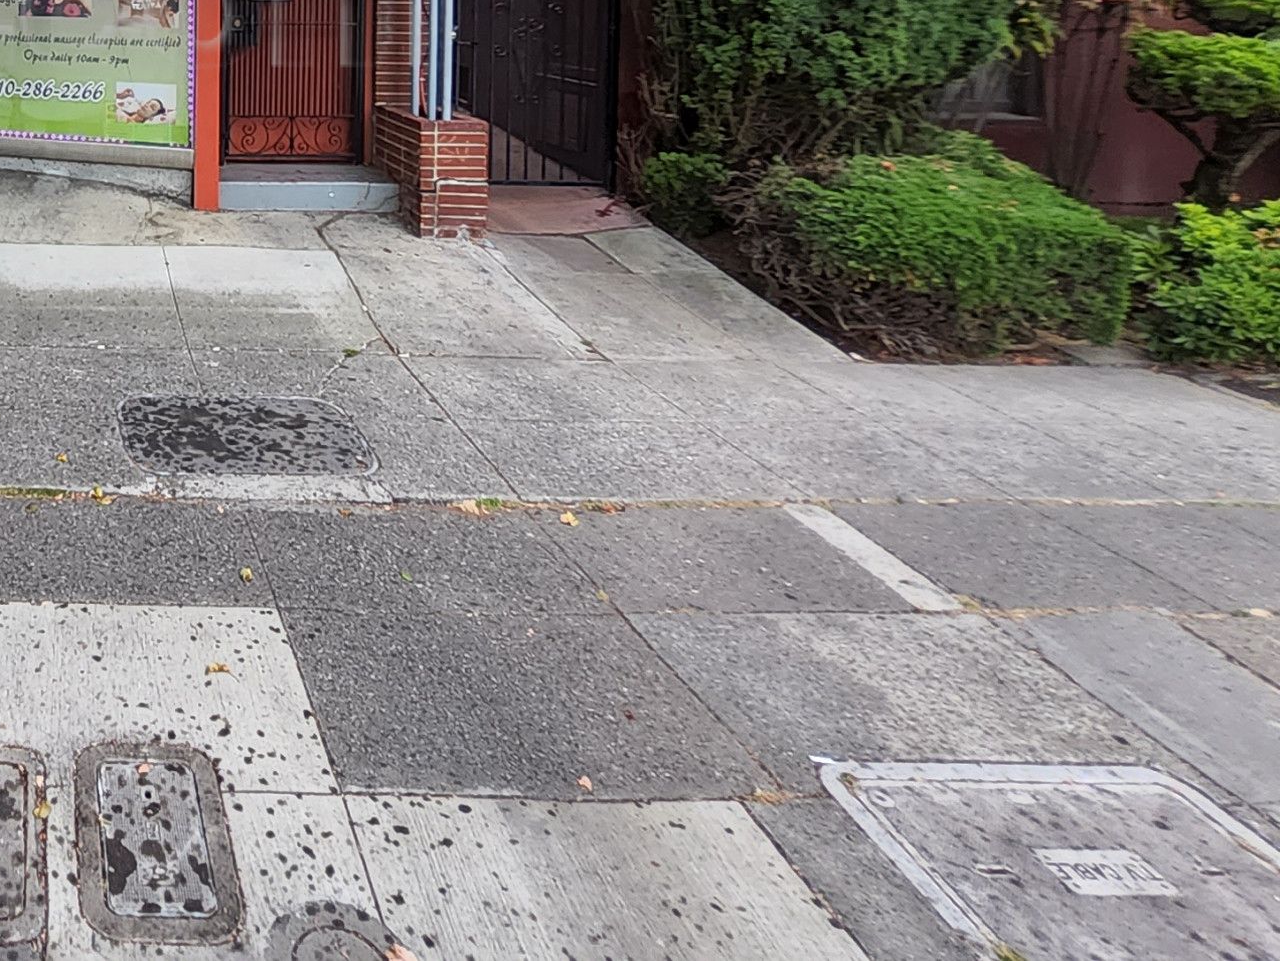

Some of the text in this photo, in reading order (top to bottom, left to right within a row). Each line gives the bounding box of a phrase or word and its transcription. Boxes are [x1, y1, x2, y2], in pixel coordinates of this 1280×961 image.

[24, 49, 49, 63] Open
[1045, 862, 1164, 882] TV CABLE
